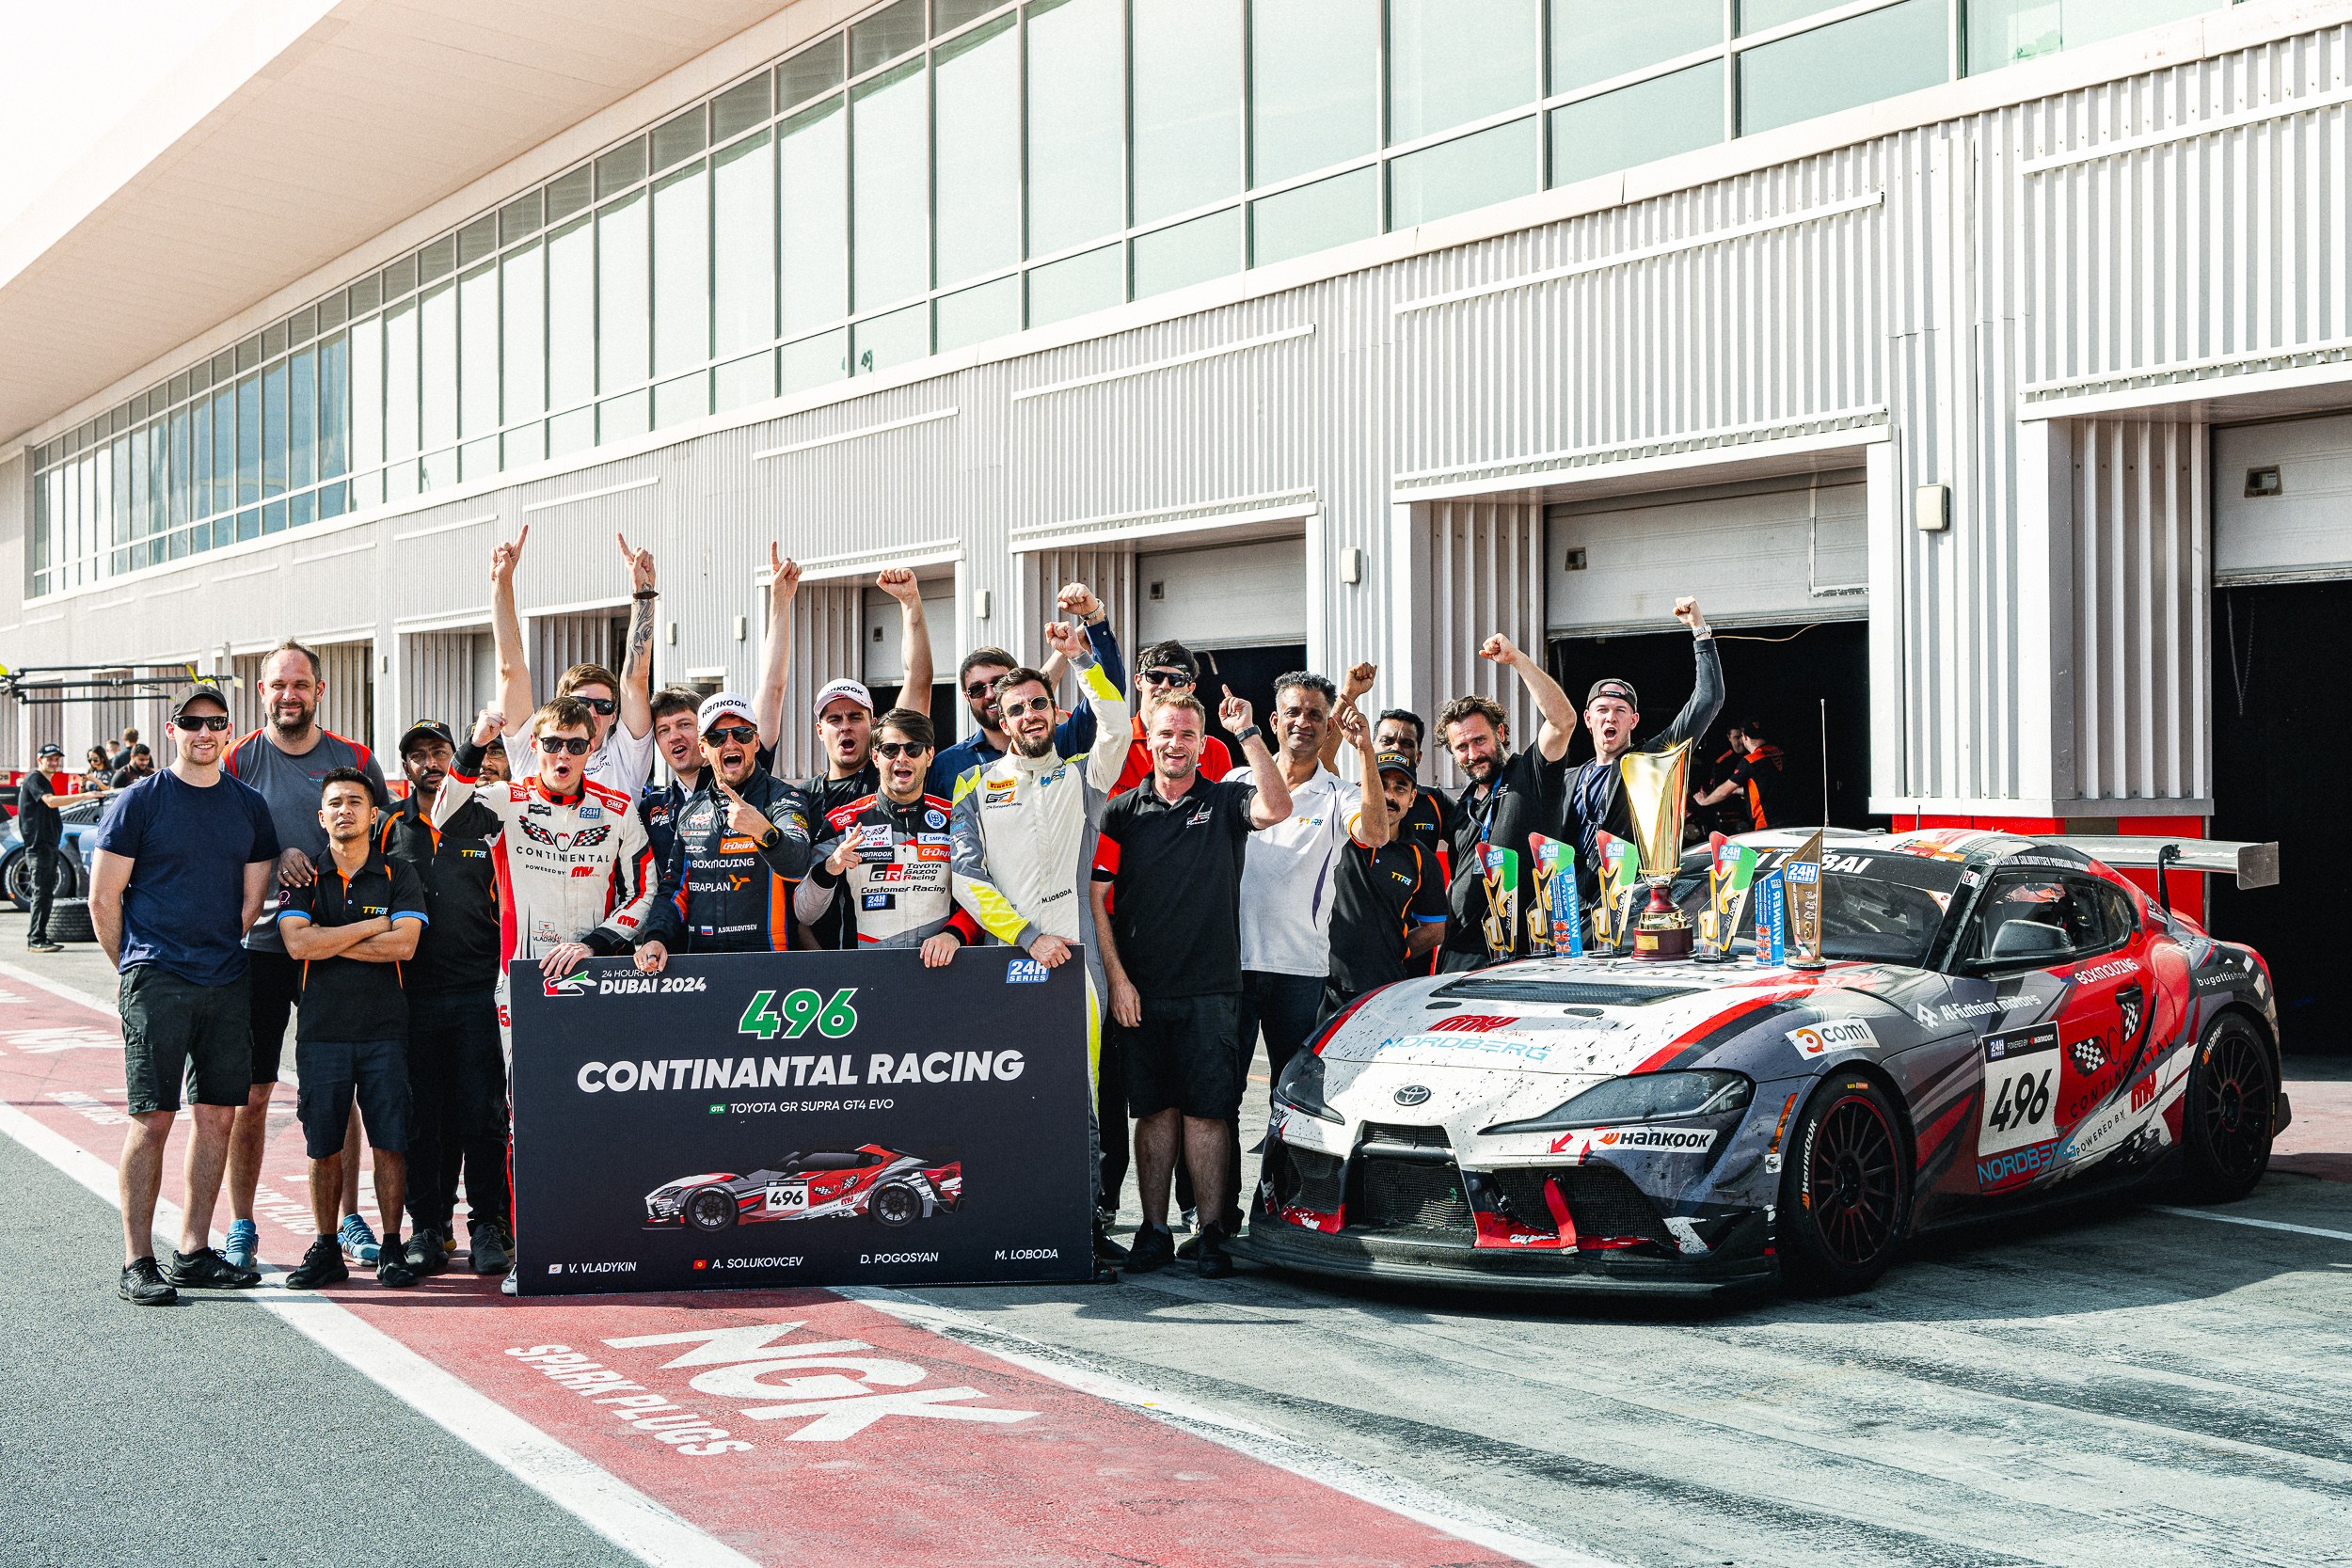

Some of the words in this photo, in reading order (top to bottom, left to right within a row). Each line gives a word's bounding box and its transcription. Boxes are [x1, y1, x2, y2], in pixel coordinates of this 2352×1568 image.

[606, 800, 623, 810] OMP
[516, 847, 611, 863] CONTINENTAL
[1542, 845, 1559, 854] 24H
[1607, 844, 1625, 853] 24H
[1721, 847, 1741, 855] 24H
[1487, 851, 1503, 862] 24H
[526, 864, 556, 875] POWERED
[870, 869, 901, 881] GR
[1788, 864, 1817, 877] 24H
[689, 881, 731, 892] TERAPLAN
[912, 885, 946, 895] Racing
[867, 895, 886, 904] 24H
[1041, 888, 1073, 904] M.LOBODA
[602, 970, 612, 978] 24
[614, 969, 644, 978] HOURS
[646, 969, 660, 977] OF
[2197, 972, 2249, 987] bugattishoes
[599, 978, 660, 995] DUBAI
[660, 976, 707, 993] 2024
[738, 987, 859, 1040] 496
[1378, 1036, 1552, 1061] NORDBERG
[1990, 1038, 2005, 1052] 24H
[2007, 1040, 2024, 1050] POWERED
[577, 1054, 859, 1094] CONTINANTAL
[866, 1050, 1025, 1085] RACING
[730, 1102, 777, 1114] TOYOTA
[779, 1101, 799, 1113] GR
[801, 1101, 840, 1112] SUPRA
[843, 1100, 866, 1110] GT4
[868, 1099, 894, 1110] EVO
[1989, 1069, 2053, 1132] 496
[2076, 1119, 2113, 1157] POWERED
[2114, 1108, 2125, 1124] BY
[1978, 1137, 2076, 1184] NORDBERG
[770, 1190, 803, 1206] 496
[860, 1254, 871, 1264] D.
[874, 1252, 939, 1263] POGOSYAN
[994, 1250, 1008, 1259] M.
[1010, 1249, 1058, 1259] LOBODA
[568, 1263, 578, 1274] V.
[580, 1261, 637, 1273] VLADYKIN
[712, 1259, 723, 1269] A.
[726, 1257, 803, 1269] SOLUKOVCEV
[601, 1320, 1044, 1442] NGK
[504, 1343, 647, 1396] SPARK
[604, 1391, 755, 1456] PLUGS
